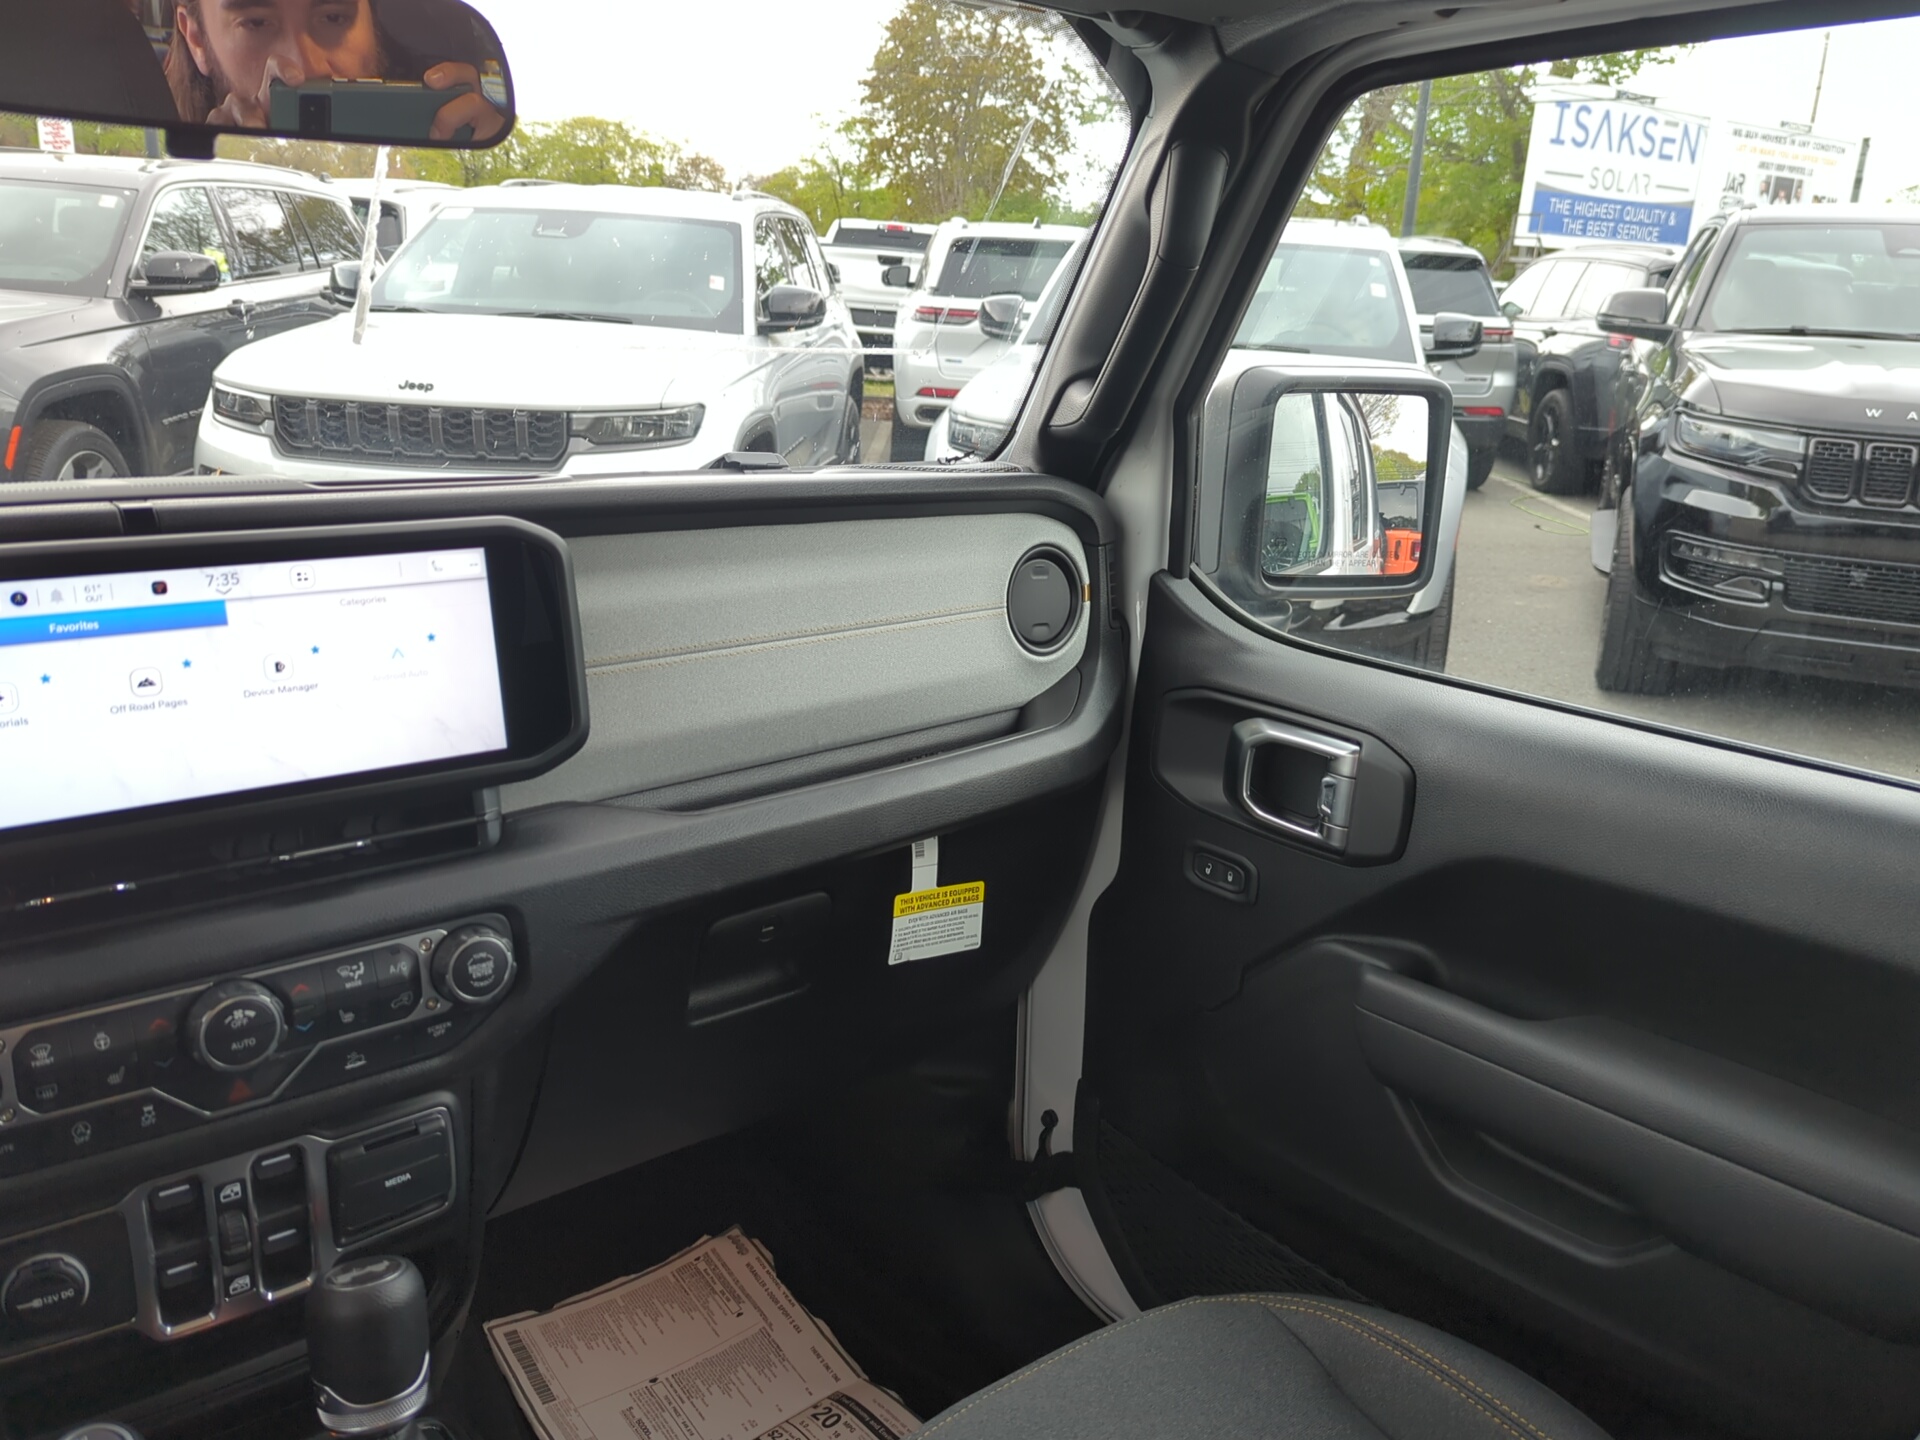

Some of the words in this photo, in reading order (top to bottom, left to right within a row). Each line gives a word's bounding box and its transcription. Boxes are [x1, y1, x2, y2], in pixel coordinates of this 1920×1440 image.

[1549, 100, 1702, 165] ISAKSEN
[1744, 130, 1759, 140] BUY
[1760, 133, 1787, 146] HOUSES
[1789, 137, 1796, 147] IN
[1812, 141, 1846, 155] CONDITION
[1589, 166, 1652, 196] SOLAR
[1550, 197, 1572, 216] THE
[1574, 200, 1621, 220] HIGHEST
[1623, 205, 1666, 225] QUALITY
[1668, 211, 1677, 226] &
[1562, 217, 1584, 235] THE
[1586, 220, 1613, 238] BEST
[1616, 222, 1660, 242] SERVICE
[398, 379, 434, 393] Jeep
[205, 572, 241, 588] 7:35
[339, 594, 387, 608] Categories
[49, 620, 100, 635] Favorites
[243, 686, 276, 699] Device
[277, 681, 319, 696] Manager
[110, 704, 127, 716] Off
[129, 701, 156, 713] Road
[158, 697, 188, 712] Pages
[899, 905, 915, 914] WITH
[916, 900, 950, 910] ADVANCED
[951, 896, 962, 904] AIR
[963, 894, 979, 902] BAGS
[900, 896, 914, 906] THIS
[915, 892, 941, 903] VEHICLE
[949, 886, 980, 897] EQUIPPED
[389, 963, 408, 975] A/C
[231, 1017, 249, 1029] OFF
[427, 1021, 452, 1033] SCREEN
[231, 1037, 256, 1051] AUTO
[384, 1172, 412, 1188] MEDIA
[745, 1261, 769, 1290] WRANGLER
[778, 1305, 793, 1324] SPORT
[765, 1267, 782, 1291] MODEL
[782, 1290, 797, 1308] YEAR
[42, 1292, 59, 1305] 12V
[60, 1289, 75, 1302] DC
[822, 1362, 834, 1376] ONLY
[832, 1372, 842, 1384] ONE
[810, 1406, 843, 1429] 20
[849, 1401, 871, 1422] Economy
[832, 1430, 841, 1439] 18
[842, 1420, 857, 1434] MPG
